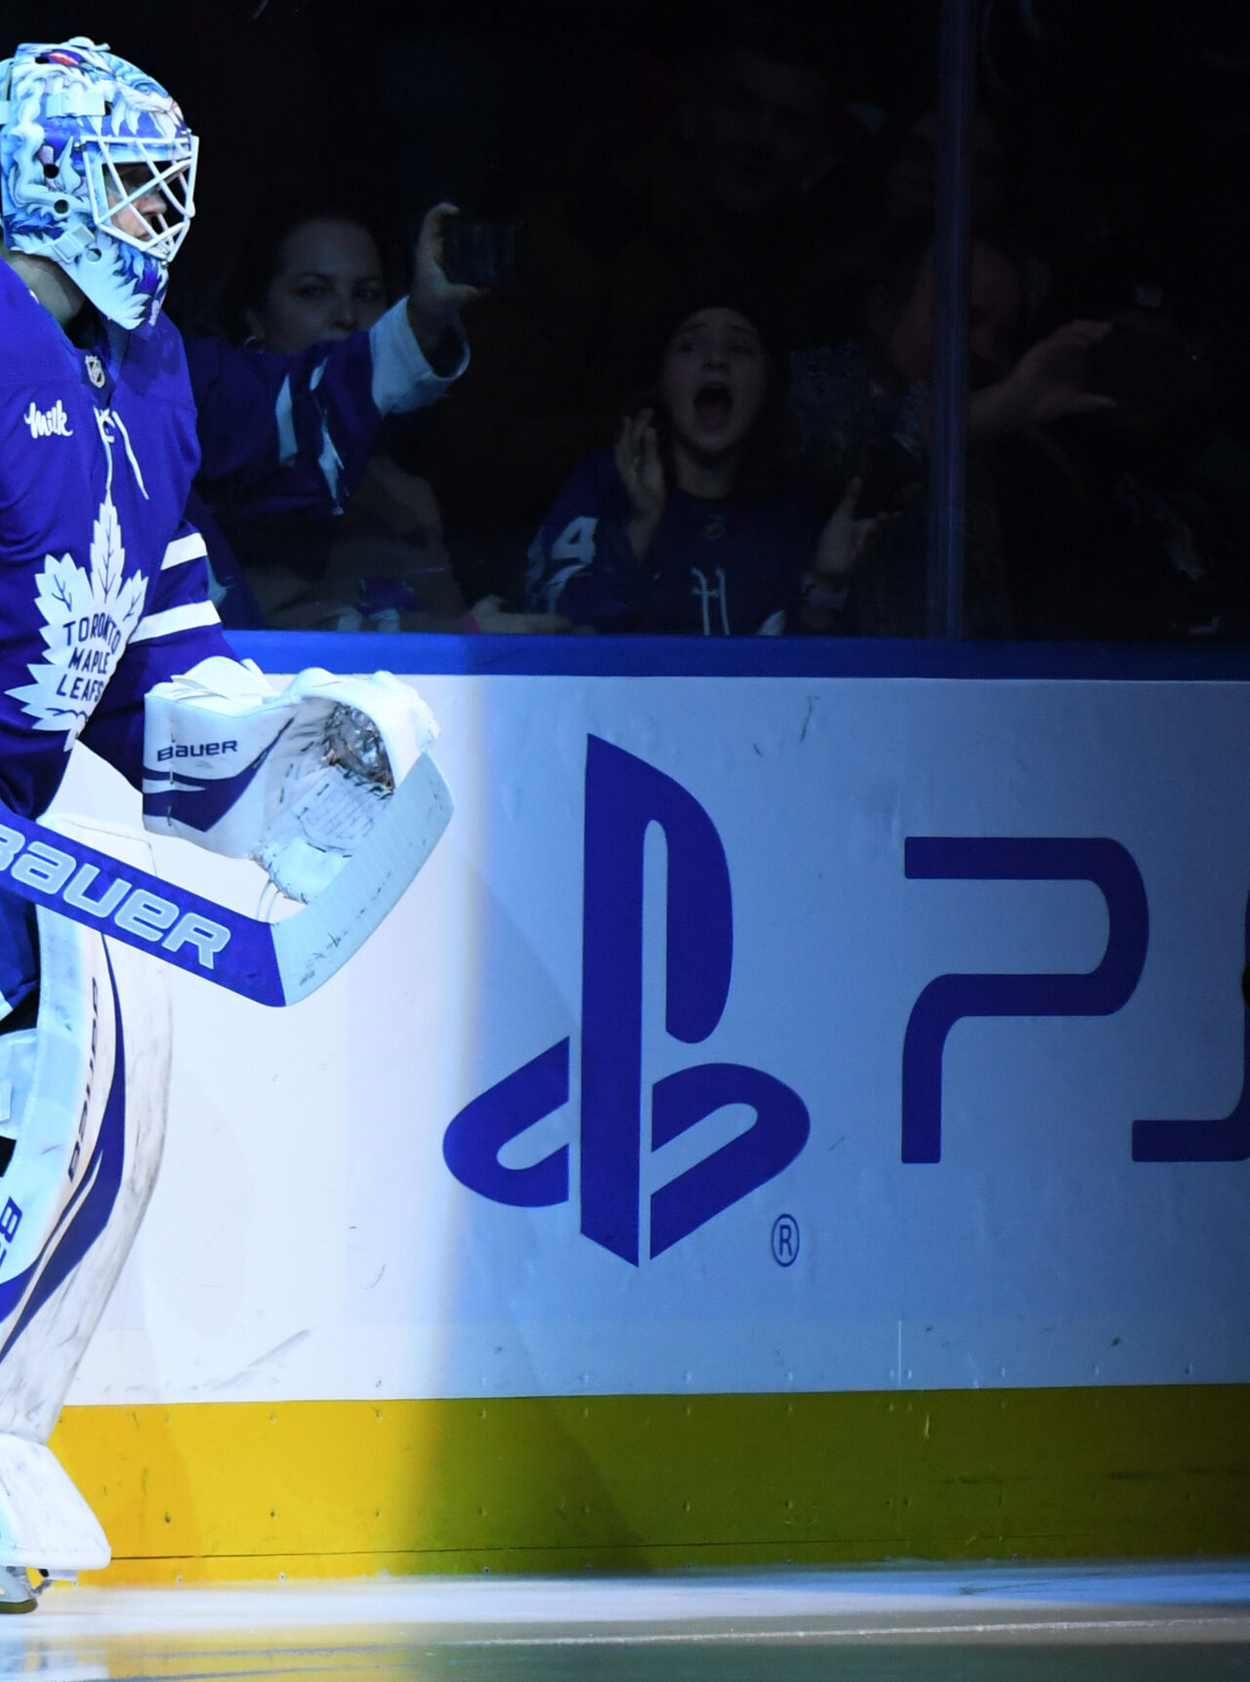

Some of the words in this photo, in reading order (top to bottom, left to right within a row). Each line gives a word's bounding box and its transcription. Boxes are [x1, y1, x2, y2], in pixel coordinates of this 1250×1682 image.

[63, 612, 121, 654] TORONTO
[68, 646, 110, 674] MAPLE
[56, 673, 104, 702] LEAFS
